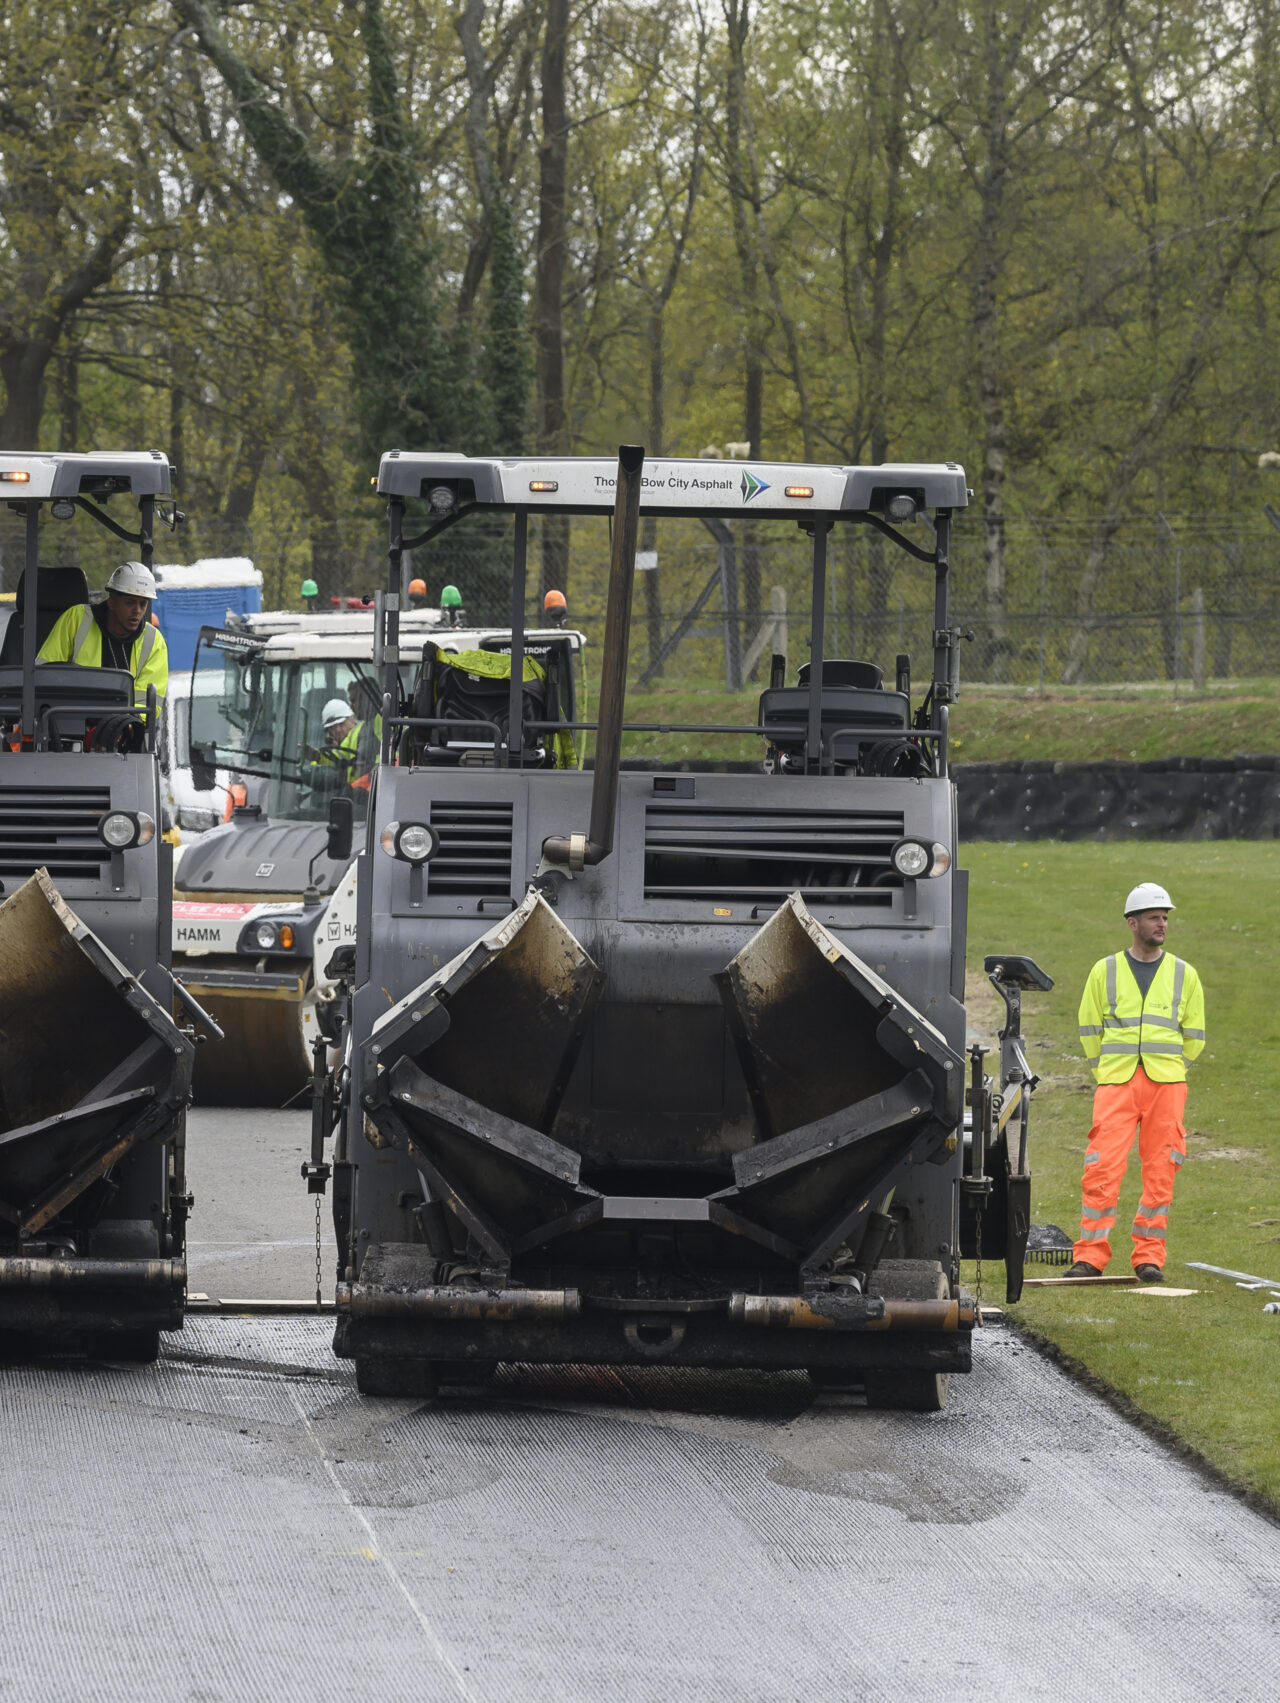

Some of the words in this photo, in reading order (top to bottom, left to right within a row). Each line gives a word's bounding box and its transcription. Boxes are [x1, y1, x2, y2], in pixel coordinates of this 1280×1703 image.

[594, 476, 618, 486] Tho
[641, 477, 665, 488] Bow
[668, 477, 689, 490] City
[691, 478, 733, 490] Asphalt
[177, 928, 221, 942] HAMM
